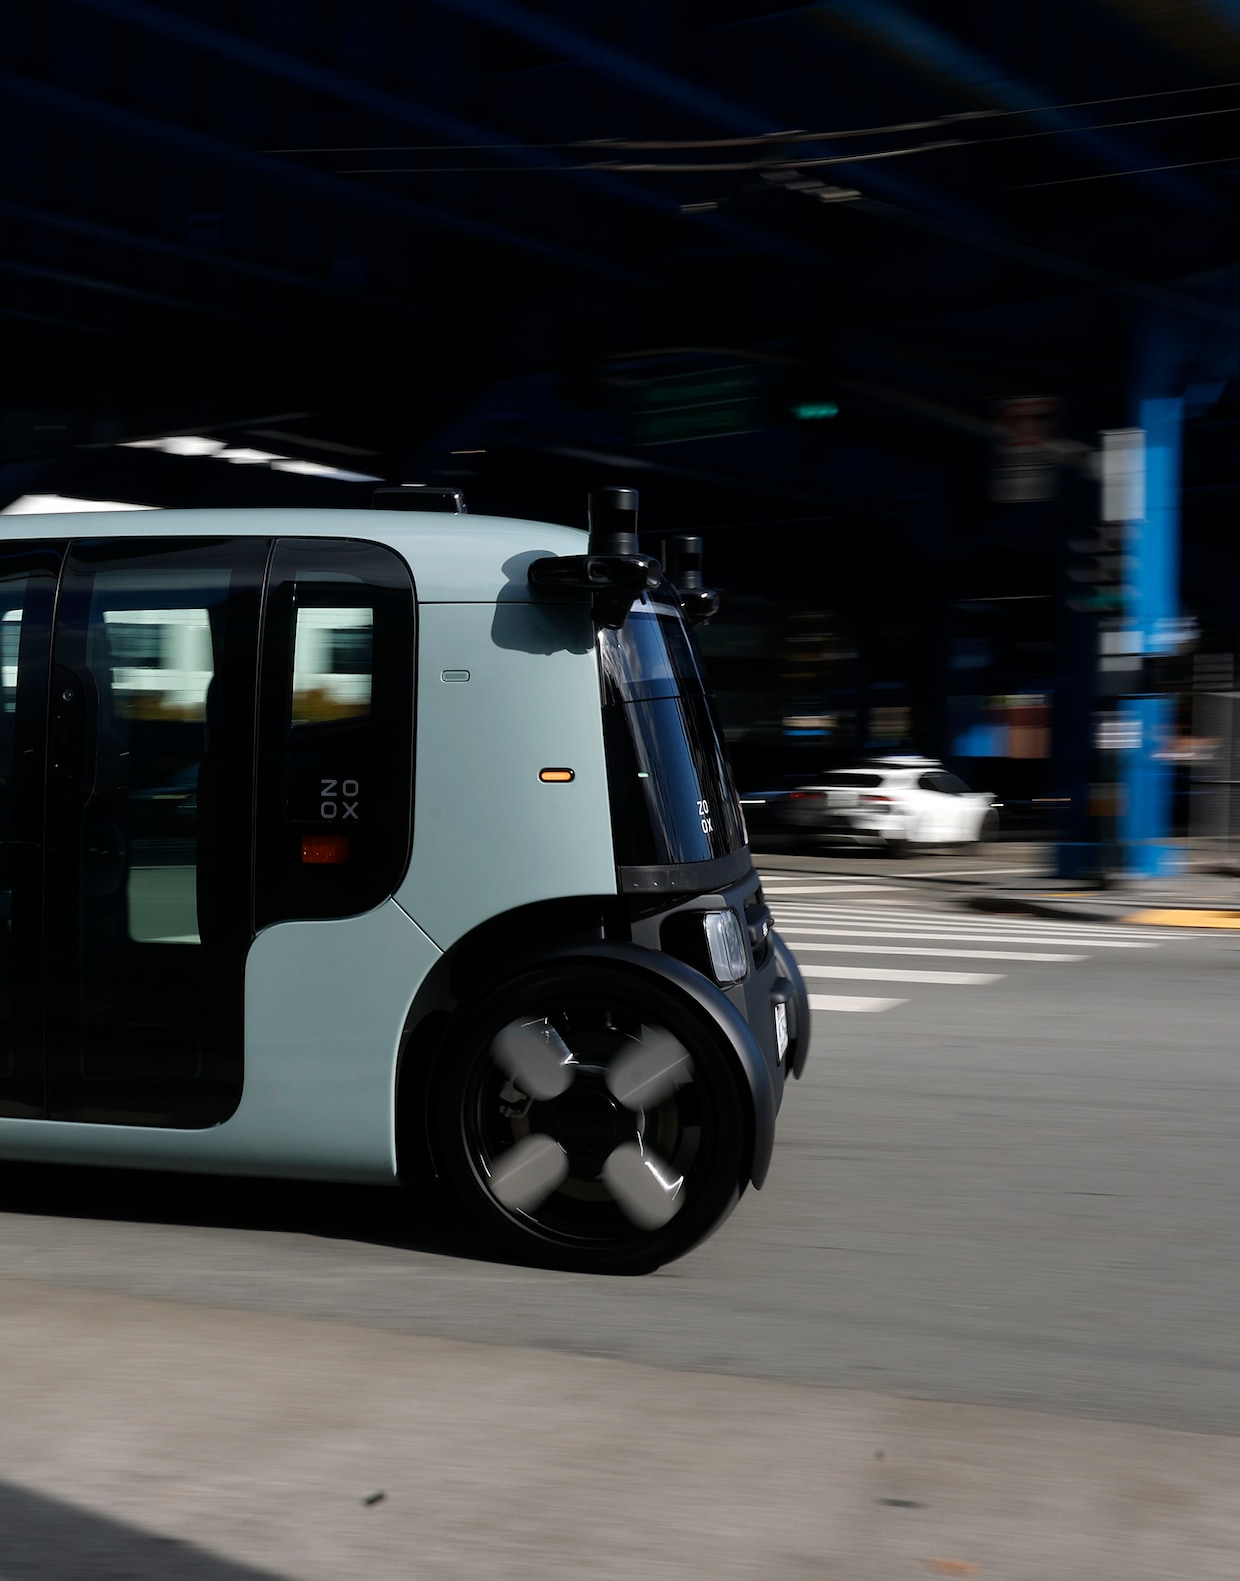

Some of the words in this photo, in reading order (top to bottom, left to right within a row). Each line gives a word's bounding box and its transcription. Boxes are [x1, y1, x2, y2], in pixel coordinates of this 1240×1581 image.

[320, 779, 359, 797] ZO
[320, 801, 359, 819] OX
[696, 800, 709, 816] ZO
[701, 818, 714, 834] OX
